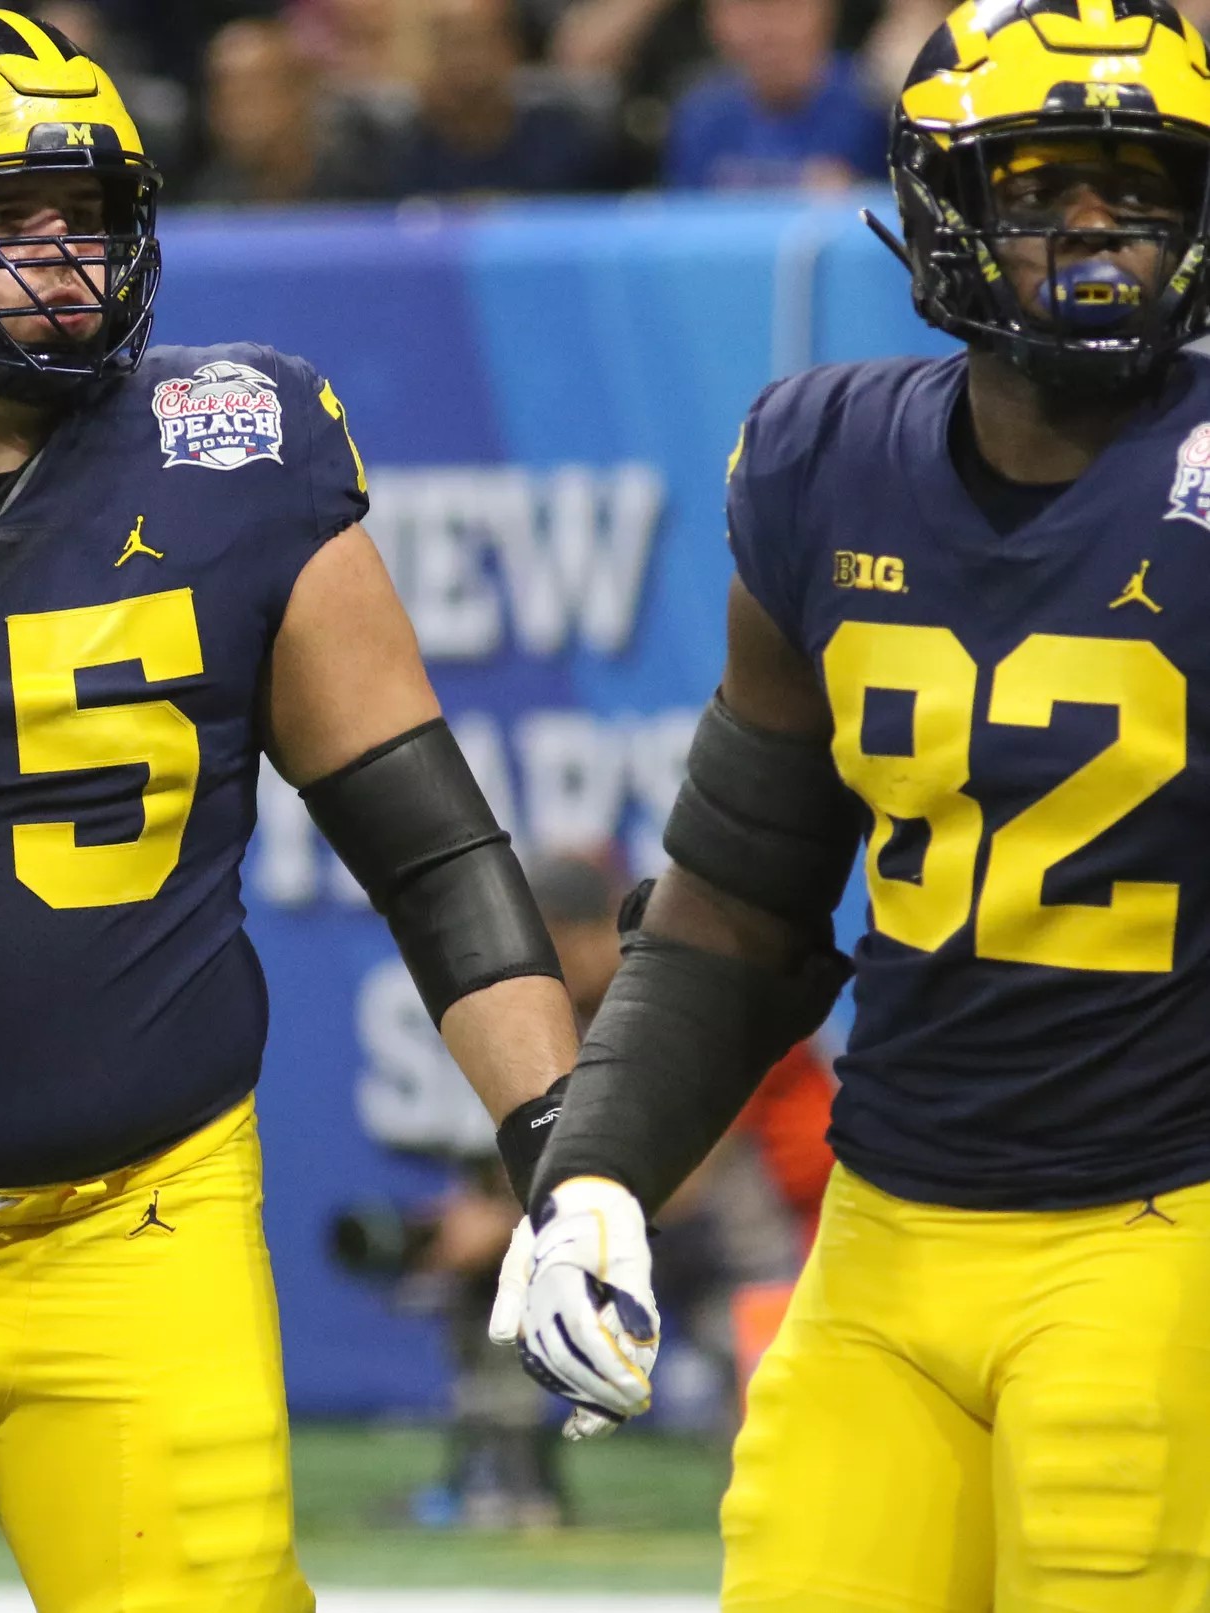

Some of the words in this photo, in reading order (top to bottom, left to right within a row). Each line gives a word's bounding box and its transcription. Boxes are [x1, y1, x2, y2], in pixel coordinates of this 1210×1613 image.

[1085, 83, 1120, 108] M
[64, 124, 94, 146] M
[163, 412, 278, 446] PEACH
[188, 436, 257, 452] BOWL
[823, 620, 1187, 973] 82
